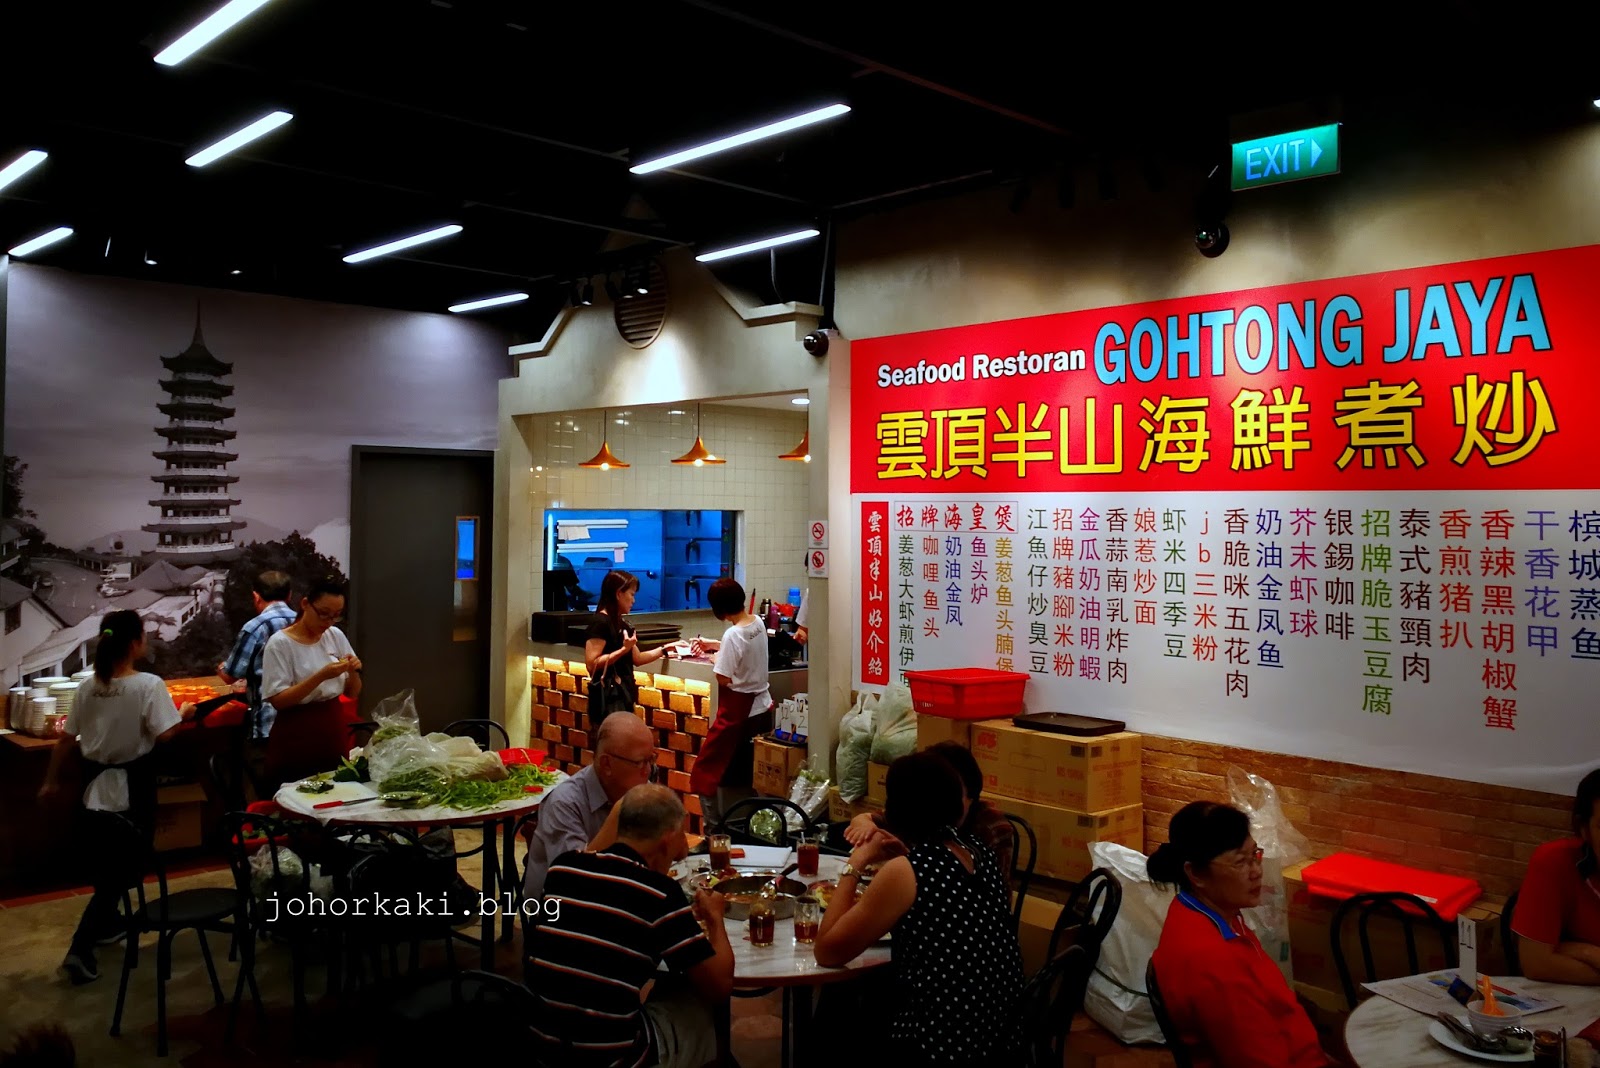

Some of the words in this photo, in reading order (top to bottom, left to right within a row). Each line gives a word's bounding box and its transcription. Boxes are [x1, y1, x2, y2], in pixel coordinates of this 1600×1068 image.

[1246, 139, 1305, 180] EXIT
[877, 356, 966, 388] Seafood
[972, 349, 1086, 379] Restoran
[1093, 294, 1364, 385] GOHTONG
[1383, 274, 1552, 365] JAYA
[875, 370, 1559, 481] 雲頂半山海鮮煮炒
[922, 535, 940, 639] 咖哩鱼头
[945, 535, 963, 627] 奶油金凤
[970, 536, 988, 605] 鱼头炉
[1027, 508, 1049, 675] 江魚仔炒臭豆
[1105, 507, 1129, 685] 香蒜南乳炸肉
[1133, 507, 1157, 626] 娘惹炒面
[1162, 507, 1187, 661] 虾米四季豆
[1223, 507, 1250, 699] 香脆咪五花肉
[1255, 507, 1284, 669] 奶油金凤鱼
[1289, 507, 1319, 639] 芥末虾球
[1360, 508, 1393, 716] 招牌脆玉豆腐
[1399, 507, 1432, 685] 泰式豬頸肉
[1438, 508, 1474, 650] 香煎猪扒
[1480, 508, 1518, 731] 香辣黑胡椒蟹
[1524, 509, 1560, 658] 干香花甲
